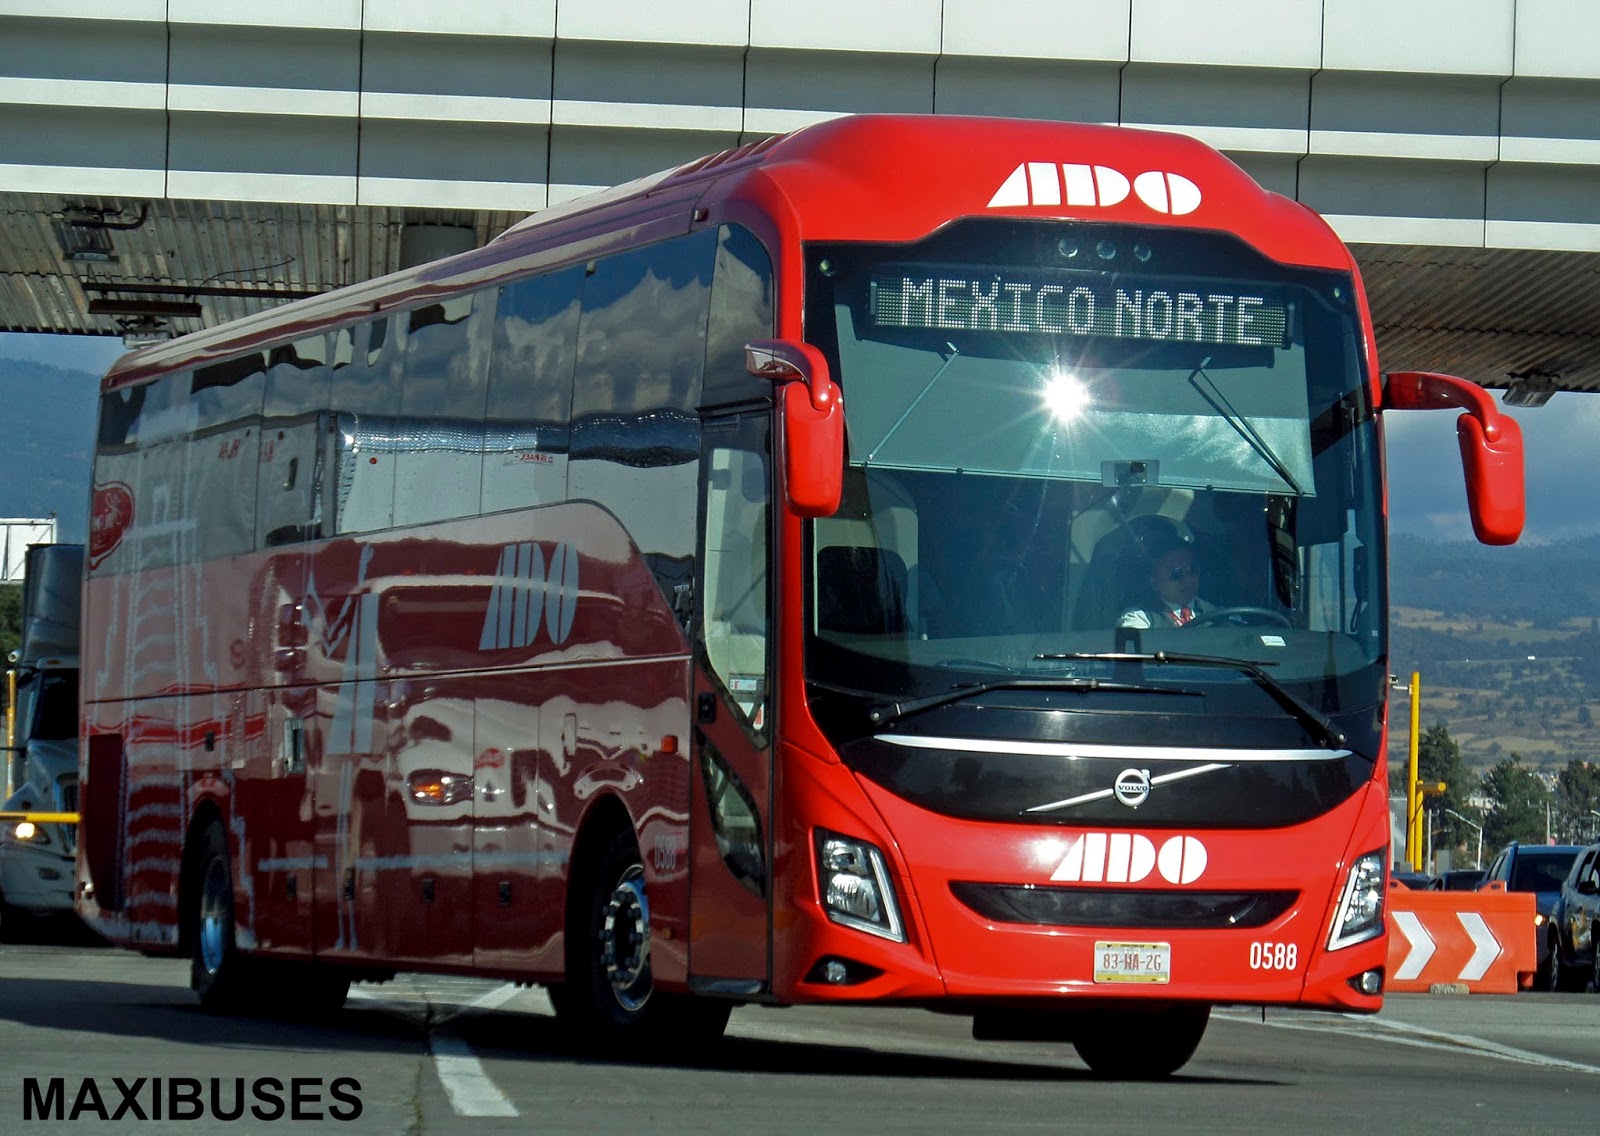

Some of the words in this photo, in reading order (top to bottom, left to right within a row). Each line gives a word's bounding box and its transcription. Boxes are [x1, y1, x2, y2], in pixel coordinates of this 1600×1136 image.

[986, 162, 1202, 215] ADO
[901, 277, 1095, 335] MEXICO
[1115, 288, 1264, 344] NORTE
[479, 540, 579, 650] ADO
[1050, 833, 1208, 885] ADO
[1103, 953, 1162, 971] 83-HA-2G
[1250, 942, 1297, 971] 0588
